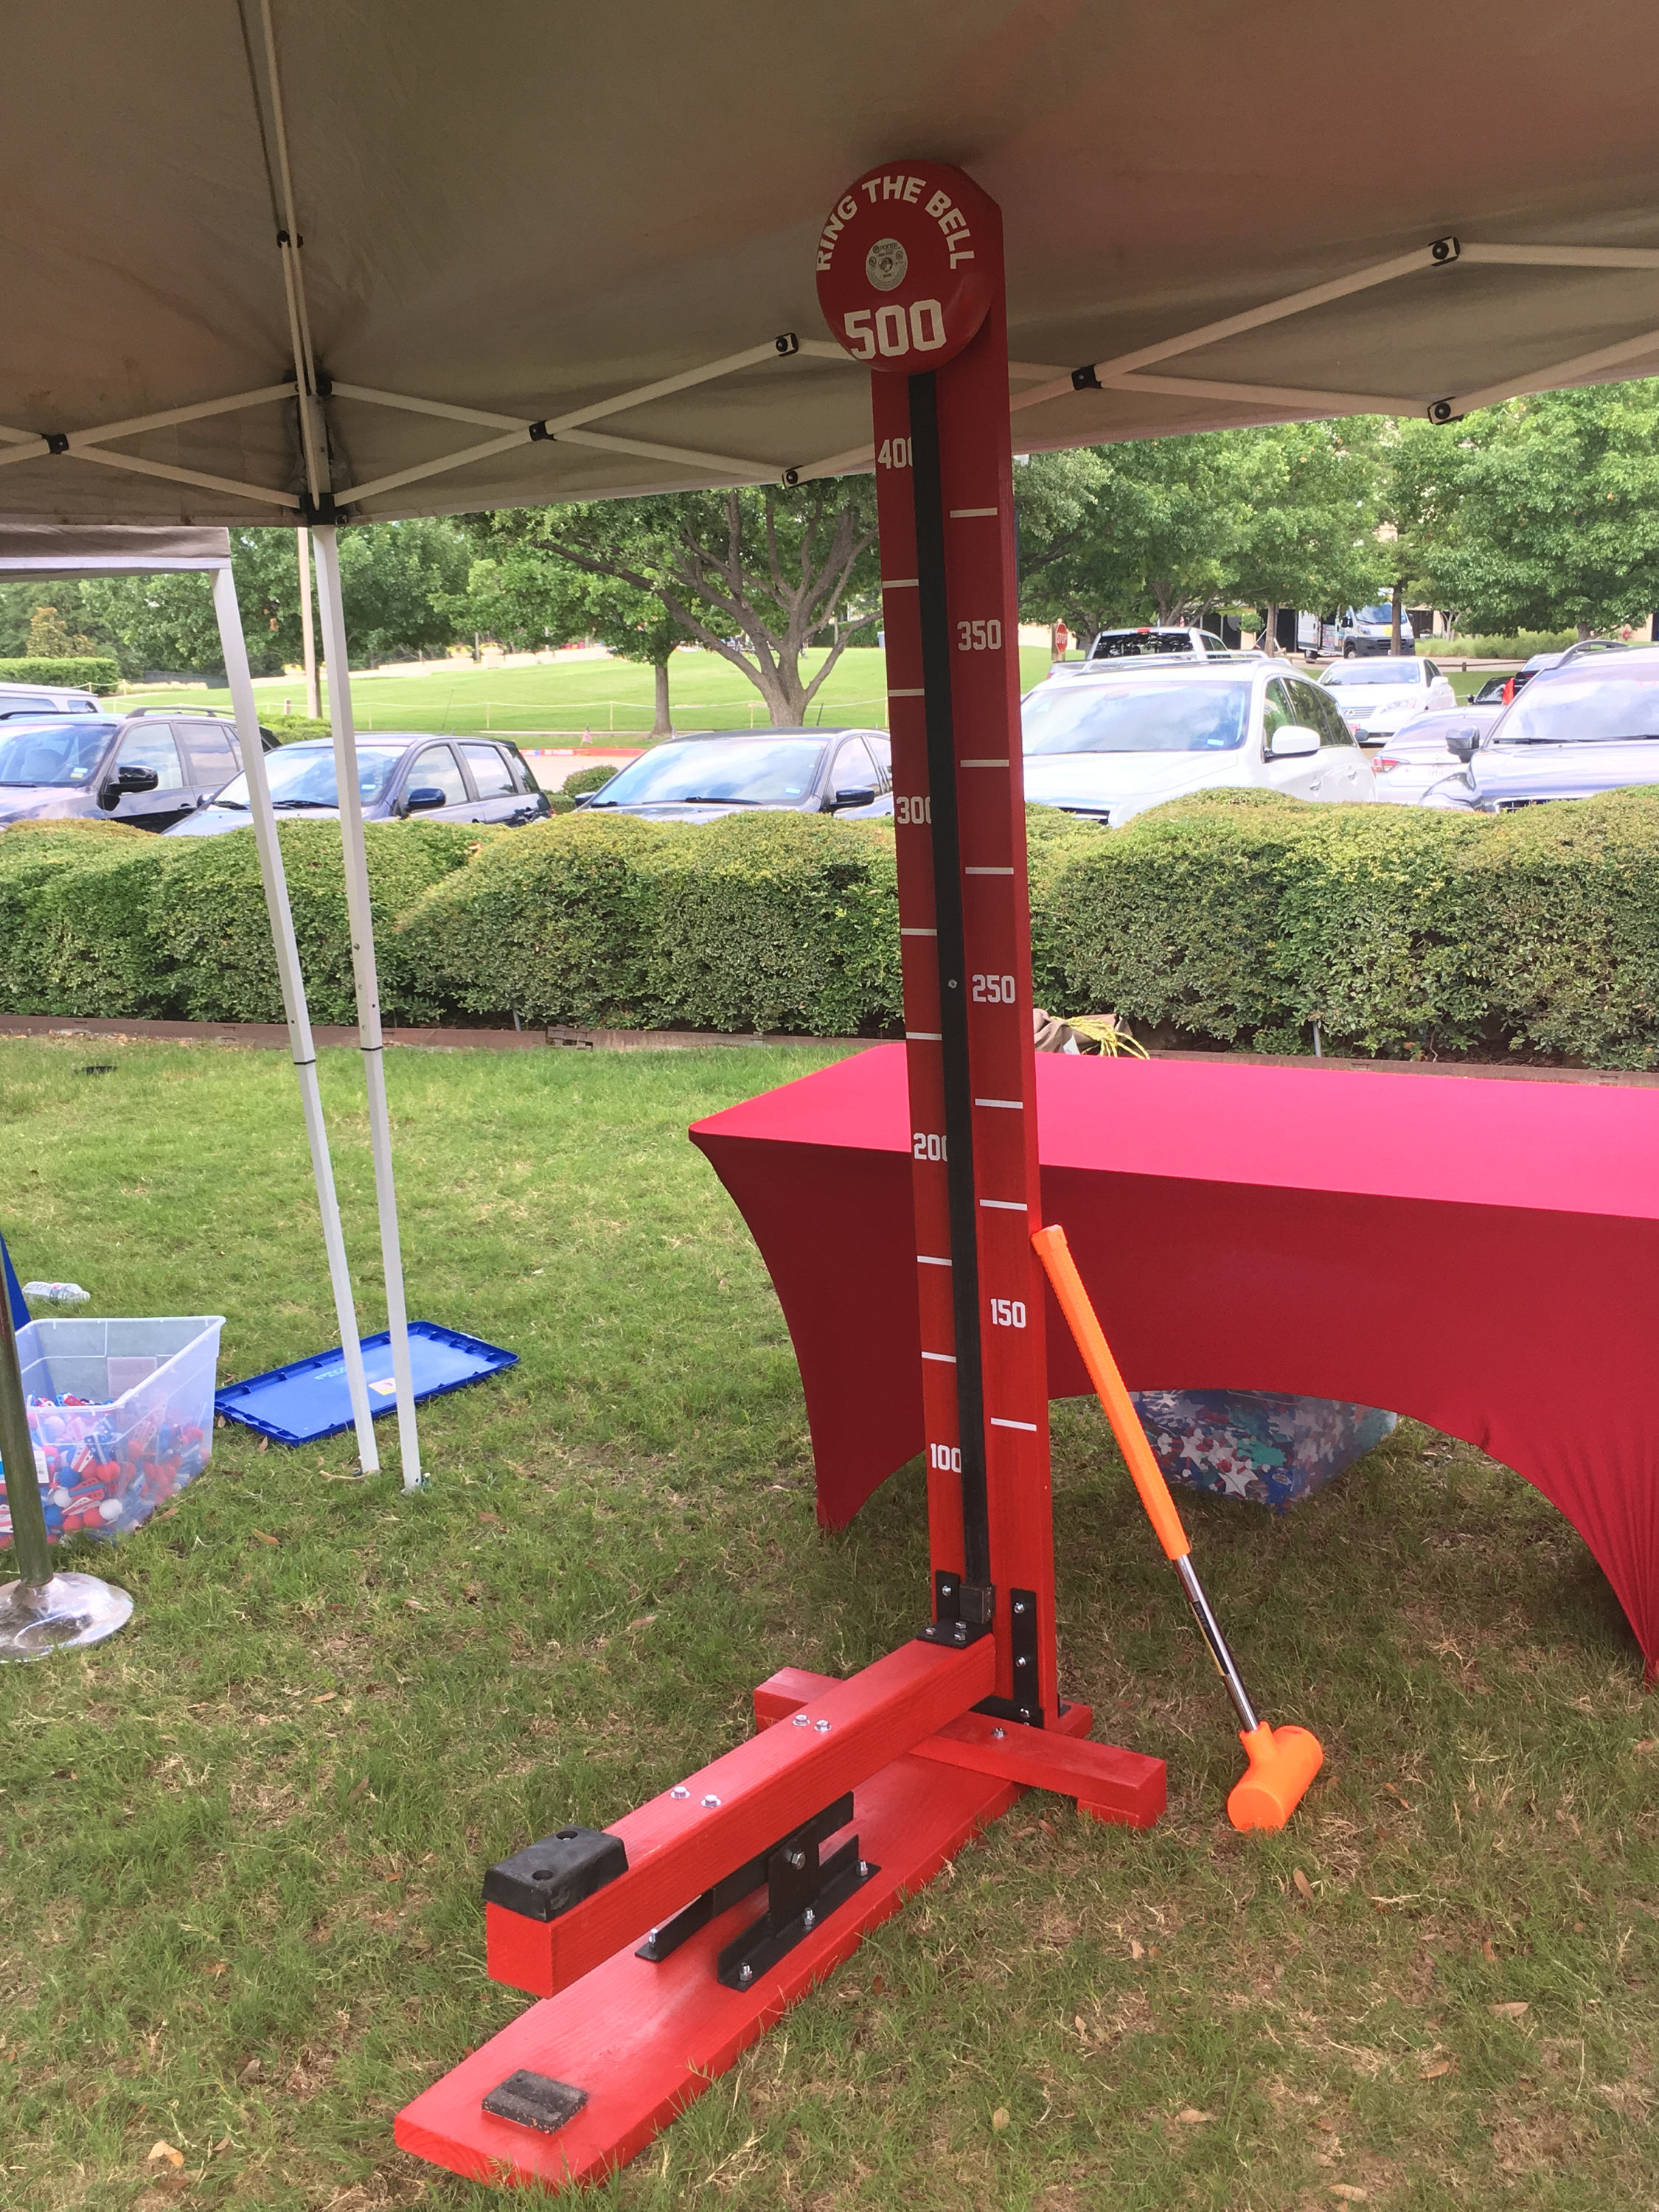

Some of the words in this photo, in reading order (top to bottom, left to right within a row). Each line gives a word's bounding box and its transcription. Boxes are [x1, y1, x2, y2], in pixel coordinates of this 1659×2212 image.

[816, 195, 858, 271] RING
[862, 175, 926, 204] THE
[925, 189, 975, 269] BELL
[844, 299, 947, 360] 500
[957, 619, 1001, 651] 350
[972, 975, 1015, 1004] 250
[990, 1298, 1026, 1328] 150
[930, 1443, 962, 1473] 100
